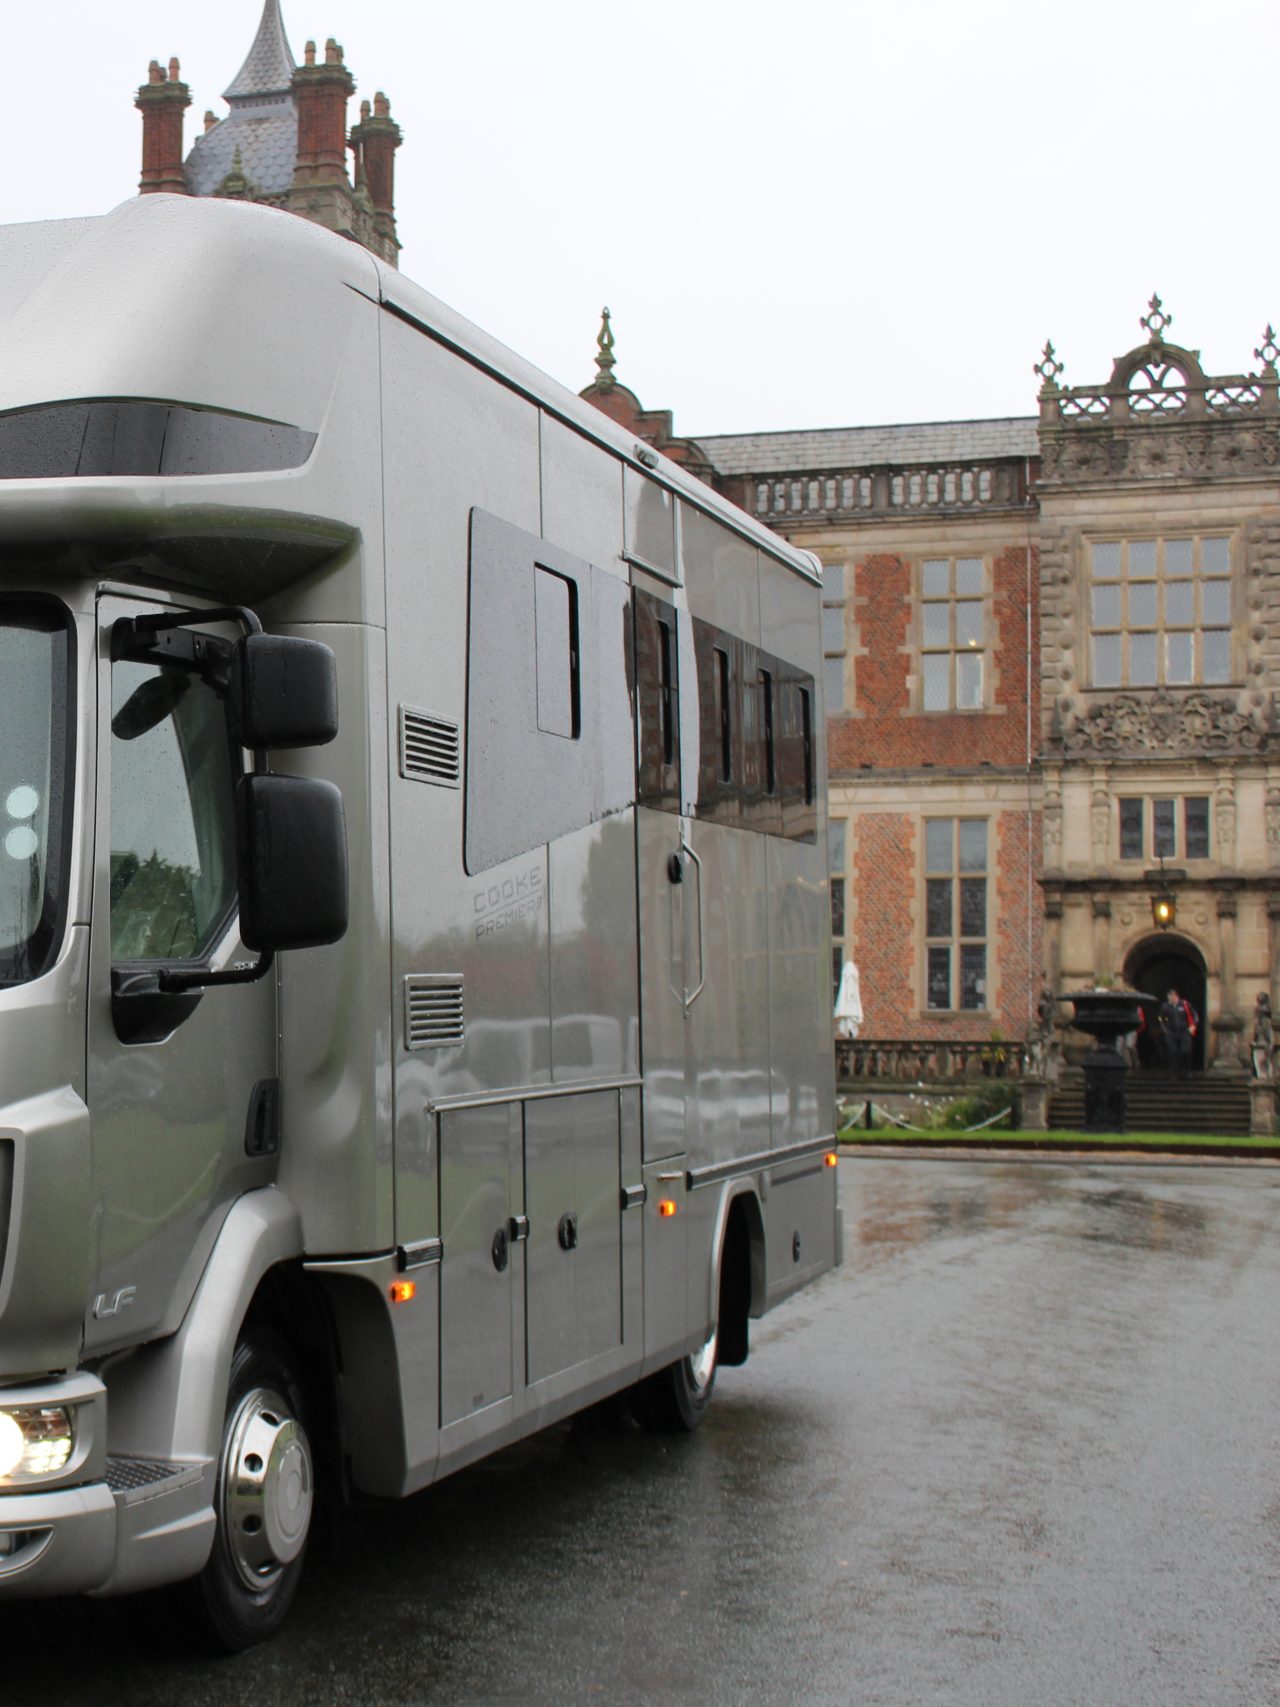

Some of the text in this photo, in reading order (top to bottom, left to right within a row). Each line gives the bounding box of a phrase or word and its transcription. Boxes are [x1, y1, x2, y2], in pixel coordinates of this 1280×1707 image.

[473, 866, 542, 914] COOKE
[475, 899, 536, 940] PREMIER
[93, 1286, 137, 1319] LF
